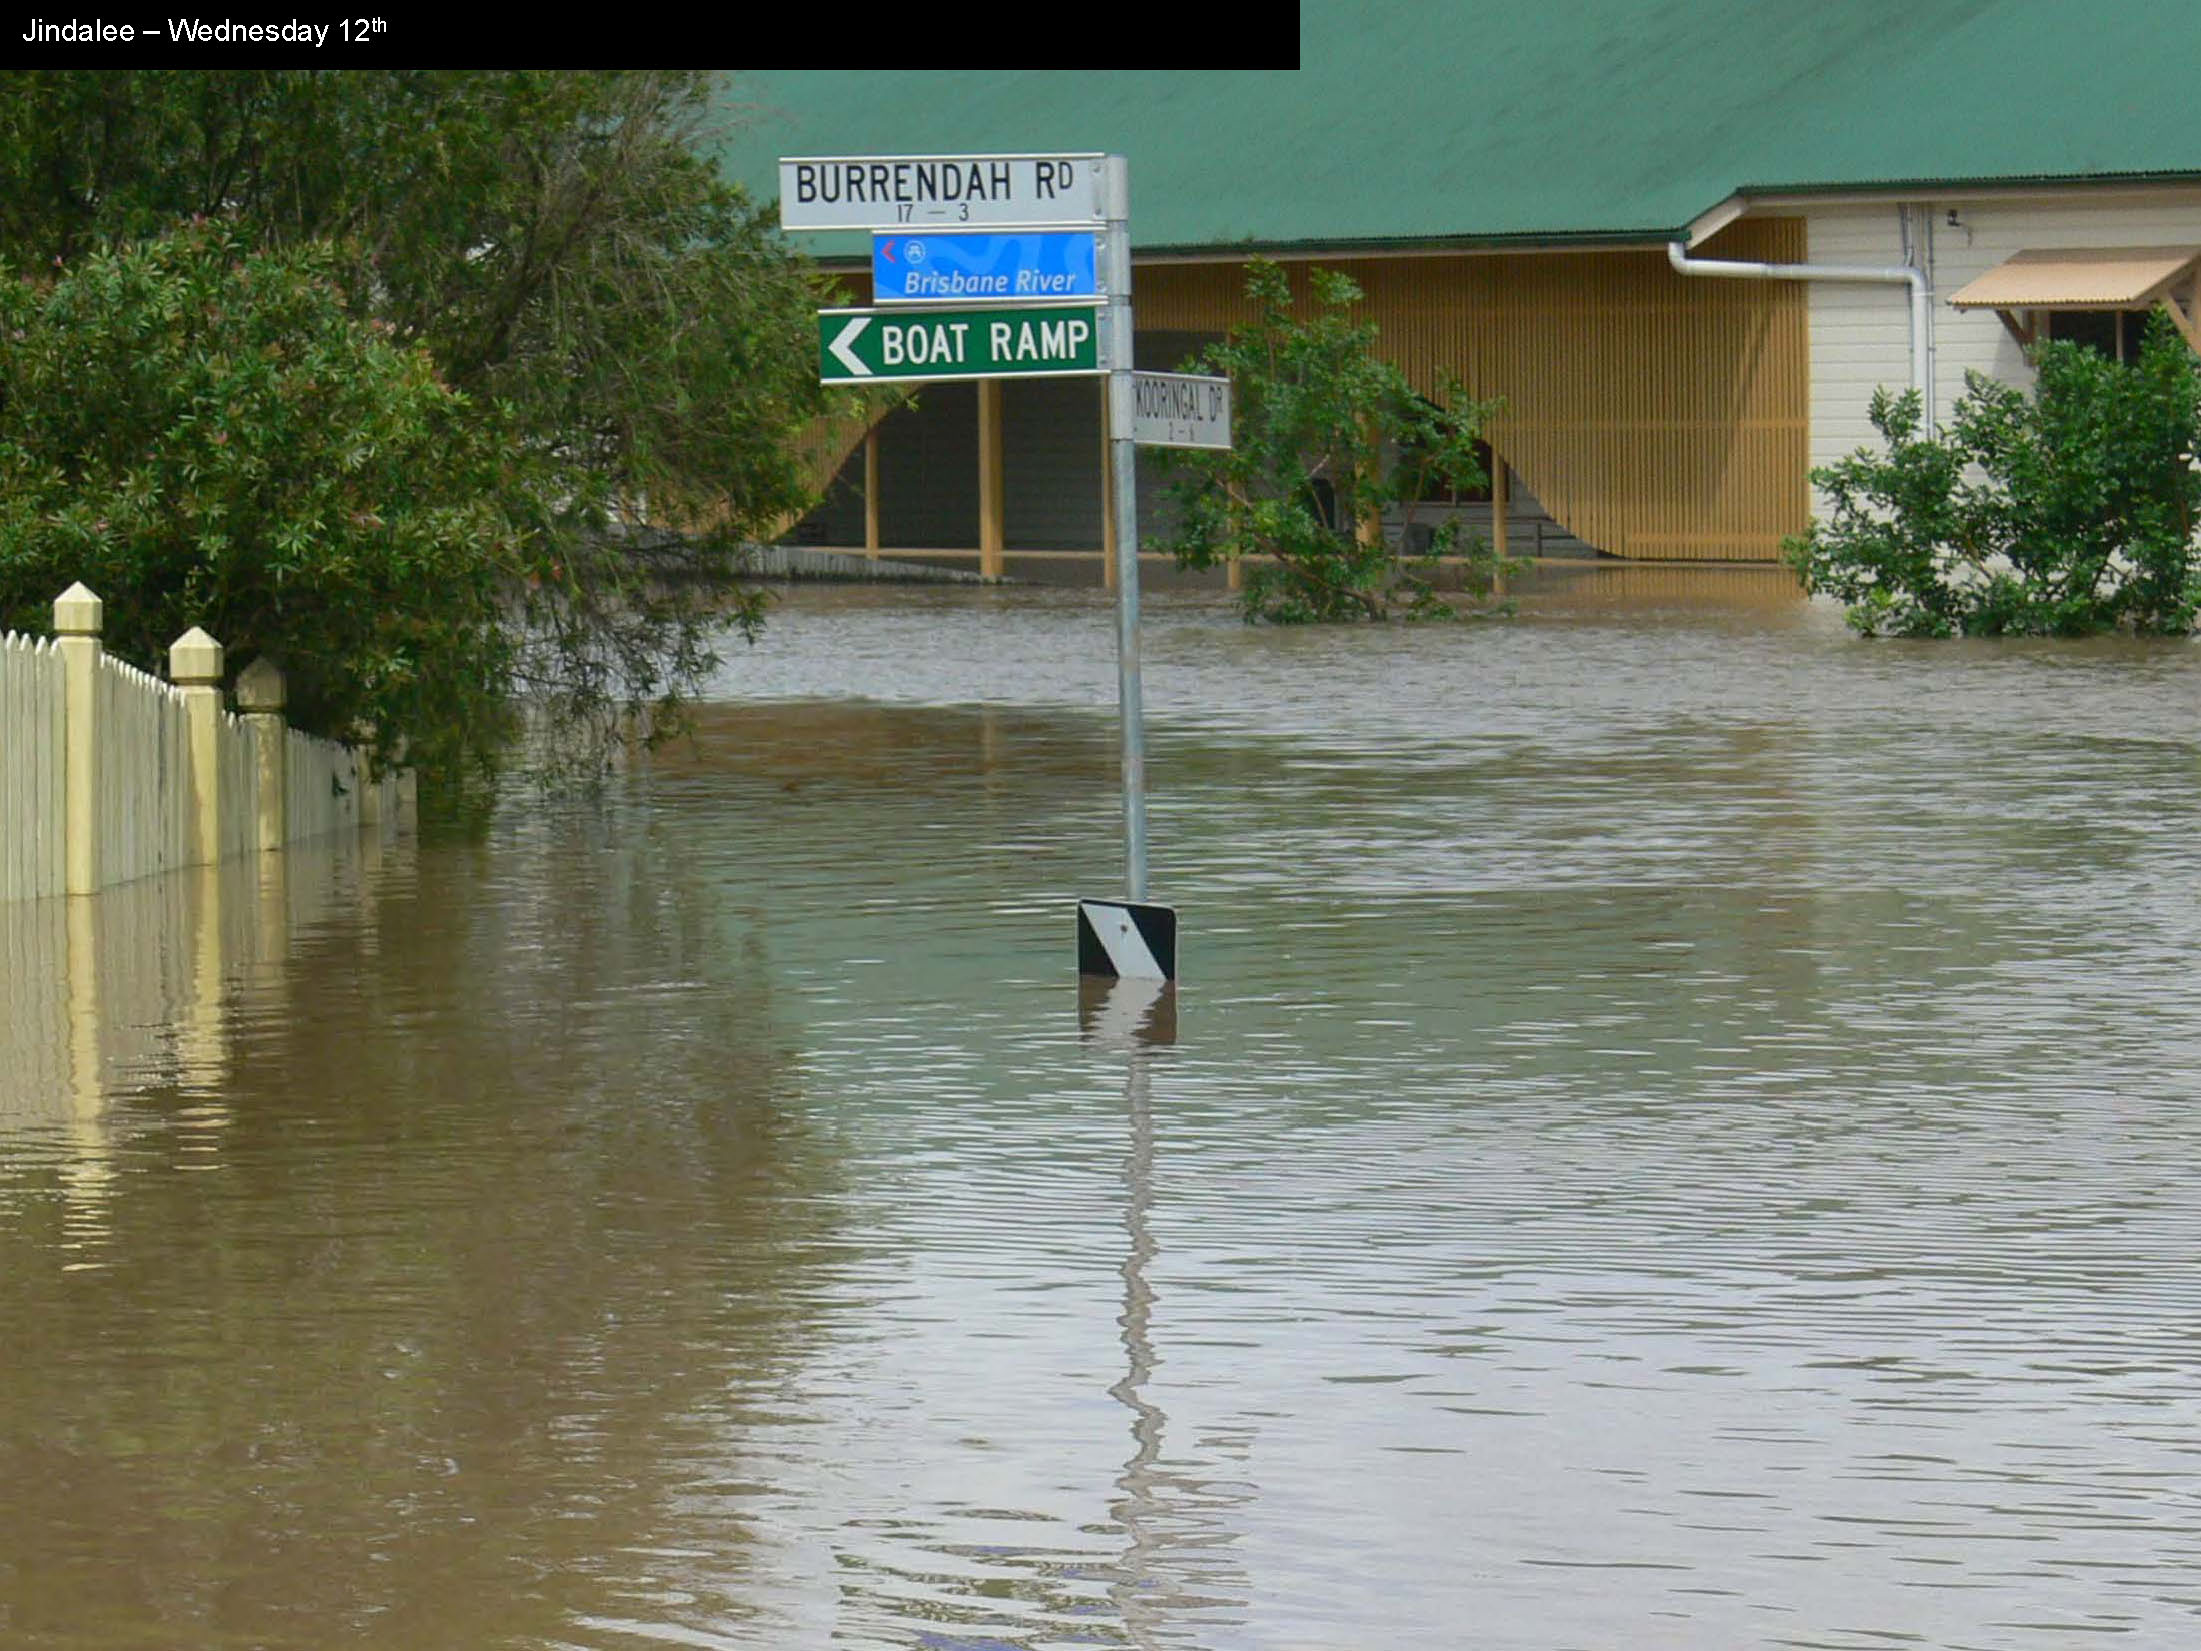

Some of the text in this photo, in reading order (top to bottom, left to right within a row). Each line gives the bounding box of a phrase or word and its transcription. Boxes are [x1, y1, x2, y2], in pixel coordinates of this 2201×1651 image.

[796, 161, 1073, 203] BURRENDAH RD
[896, 204, 913, 223] 17
[958, 203, 970, 222] 3
[904, 268, 1076, 294] Brisbane River
[882, 319, 1089, 365] BOAT RAMP
[1135, 379, 1223, 422] KOORINGAL DR
